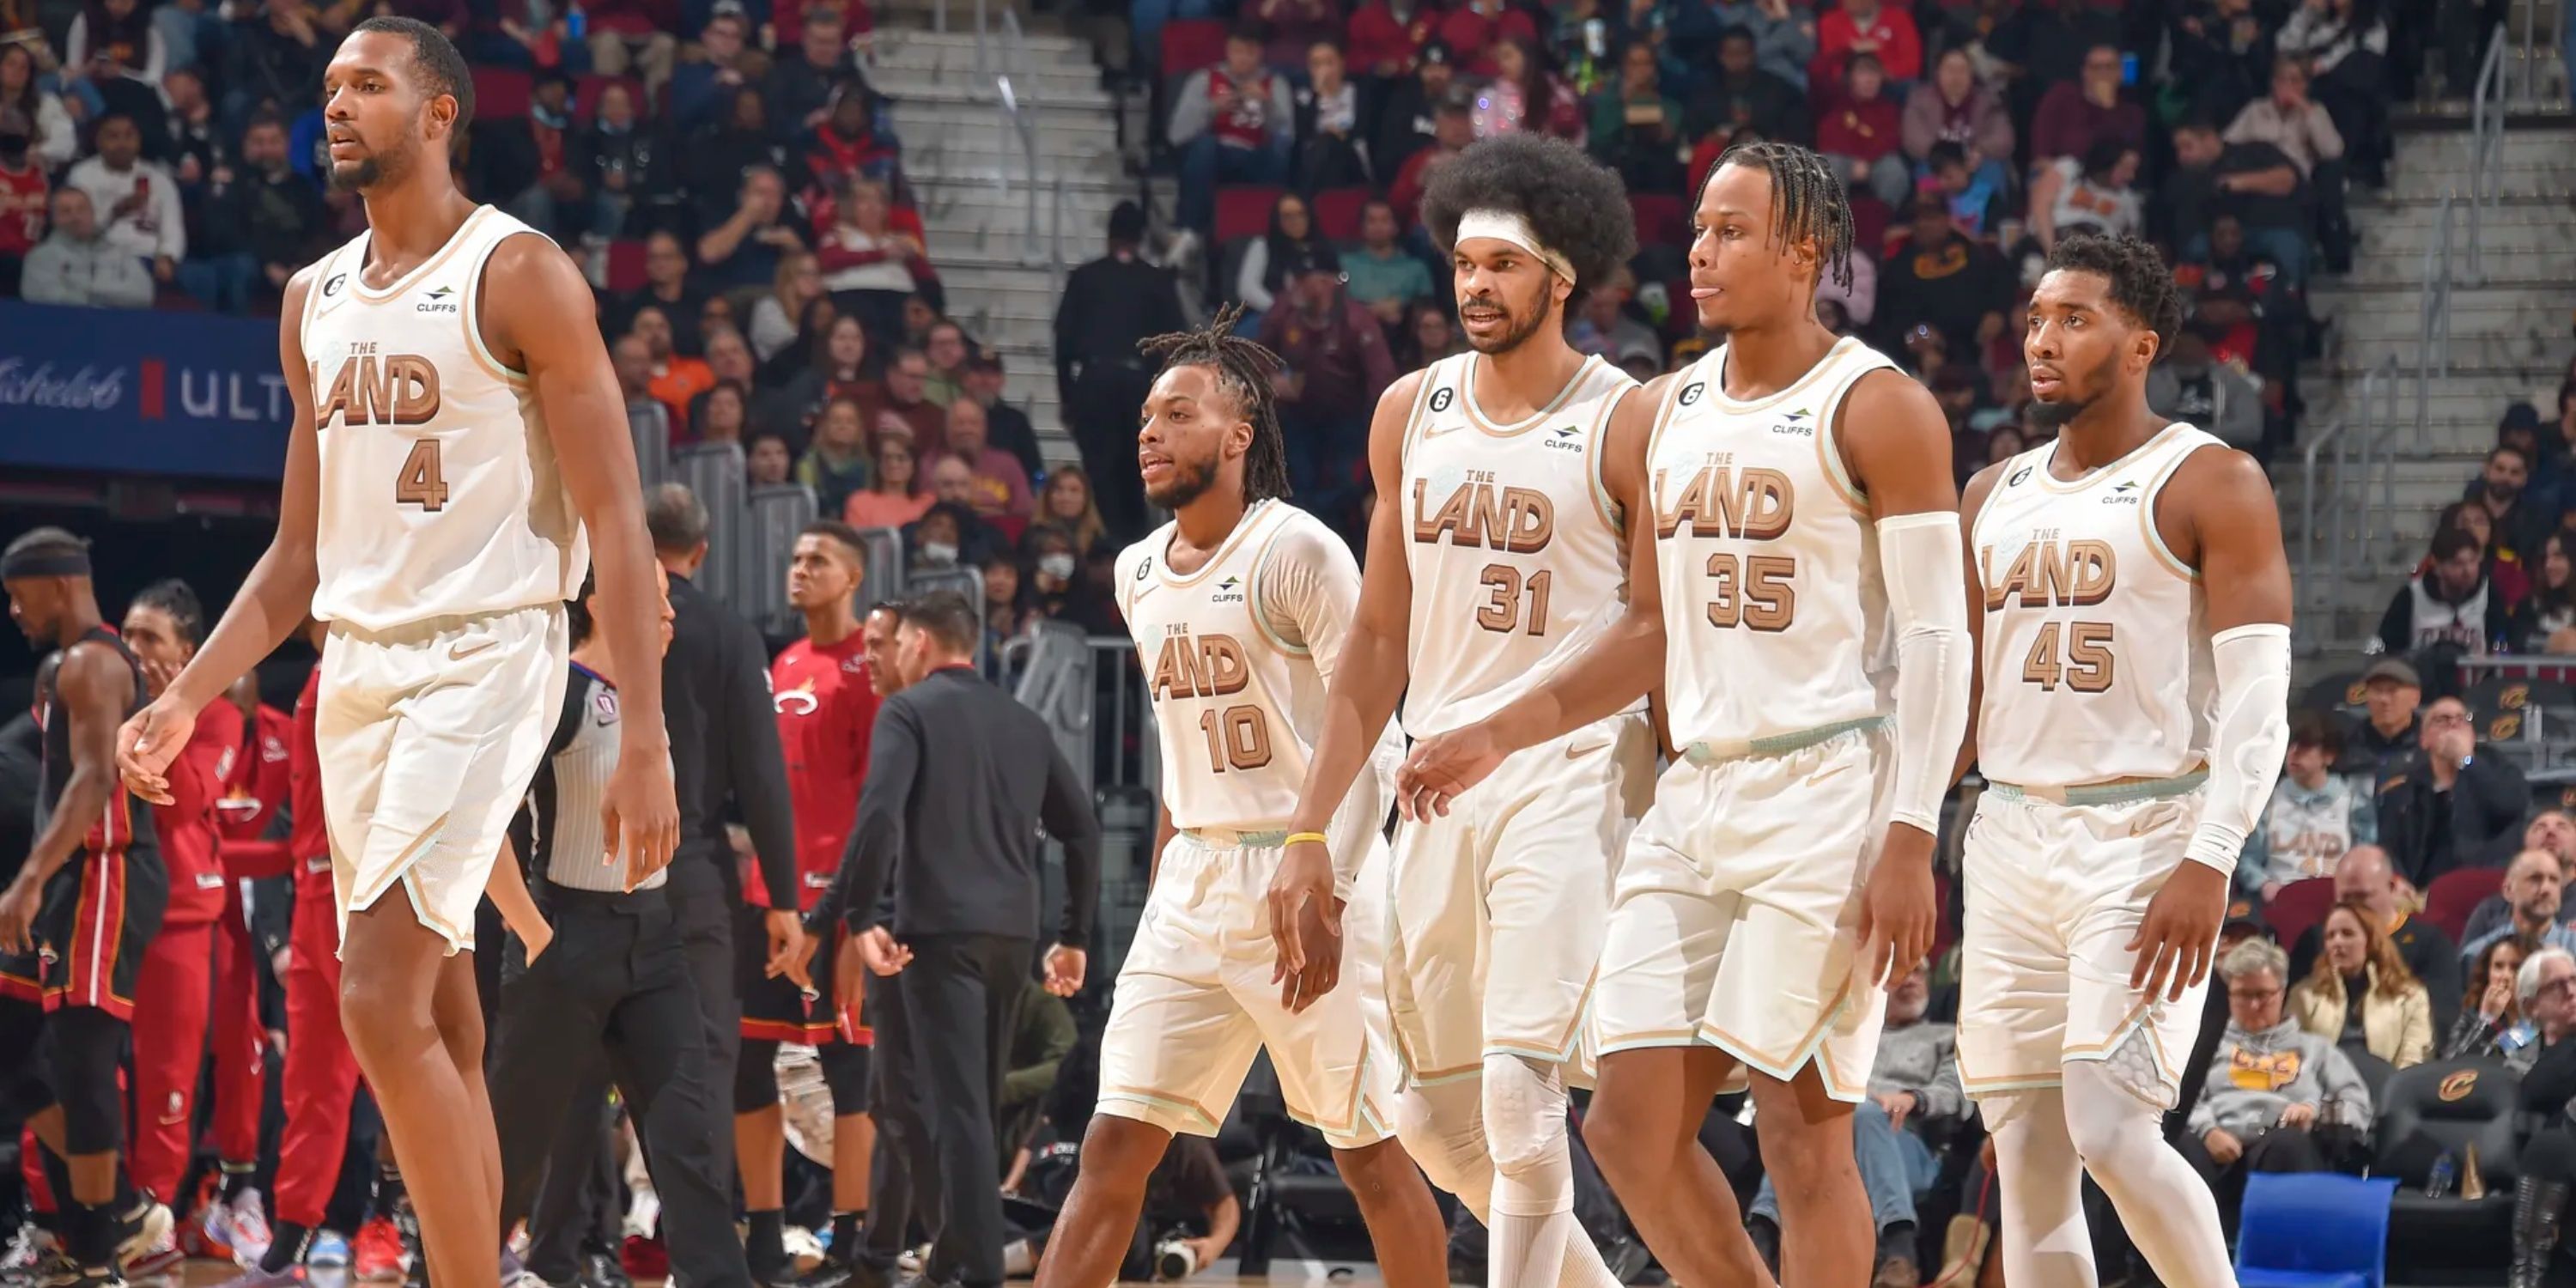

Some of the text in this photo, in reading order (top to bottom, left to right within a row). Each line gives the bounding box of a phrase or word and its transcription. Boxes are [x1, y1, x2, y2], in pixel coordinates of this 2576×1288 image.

[416, 303, 457, 313] CLIFFS
[350, 342, 378, 355] THE
[1430, 387, 1454, 412] 6
[1680, 382, 1704, 406] 6
[1772, 424, 1813, 437] CLIFFS
[1544, 439, 1583, 453] CLIFFS
[1706, 452, 1735, 465] THE
[396, 439, 448, 513] 4
[1466, 469, 1496, 483] THE
[1655, 466, 1795, 542] LAND
[2101, 495, 2138, 505] CLIFFS
[1413, 477, 1555, 555] LAND
[2032, 527, 2061, 540] THE
[1982, 538, 2117, 613] LAND
[1212, 593, 1243, 603] CLIFFS
[1477, 563, 1552, 637] 31
[1706, 553, 1795, 633] 35
[1165, 622, 1189, 636] THE
[1137, 633, 1250, 702] AND
[2022, 621, 2115, 694] 45
[1199, 704, 1273, 774] 10
